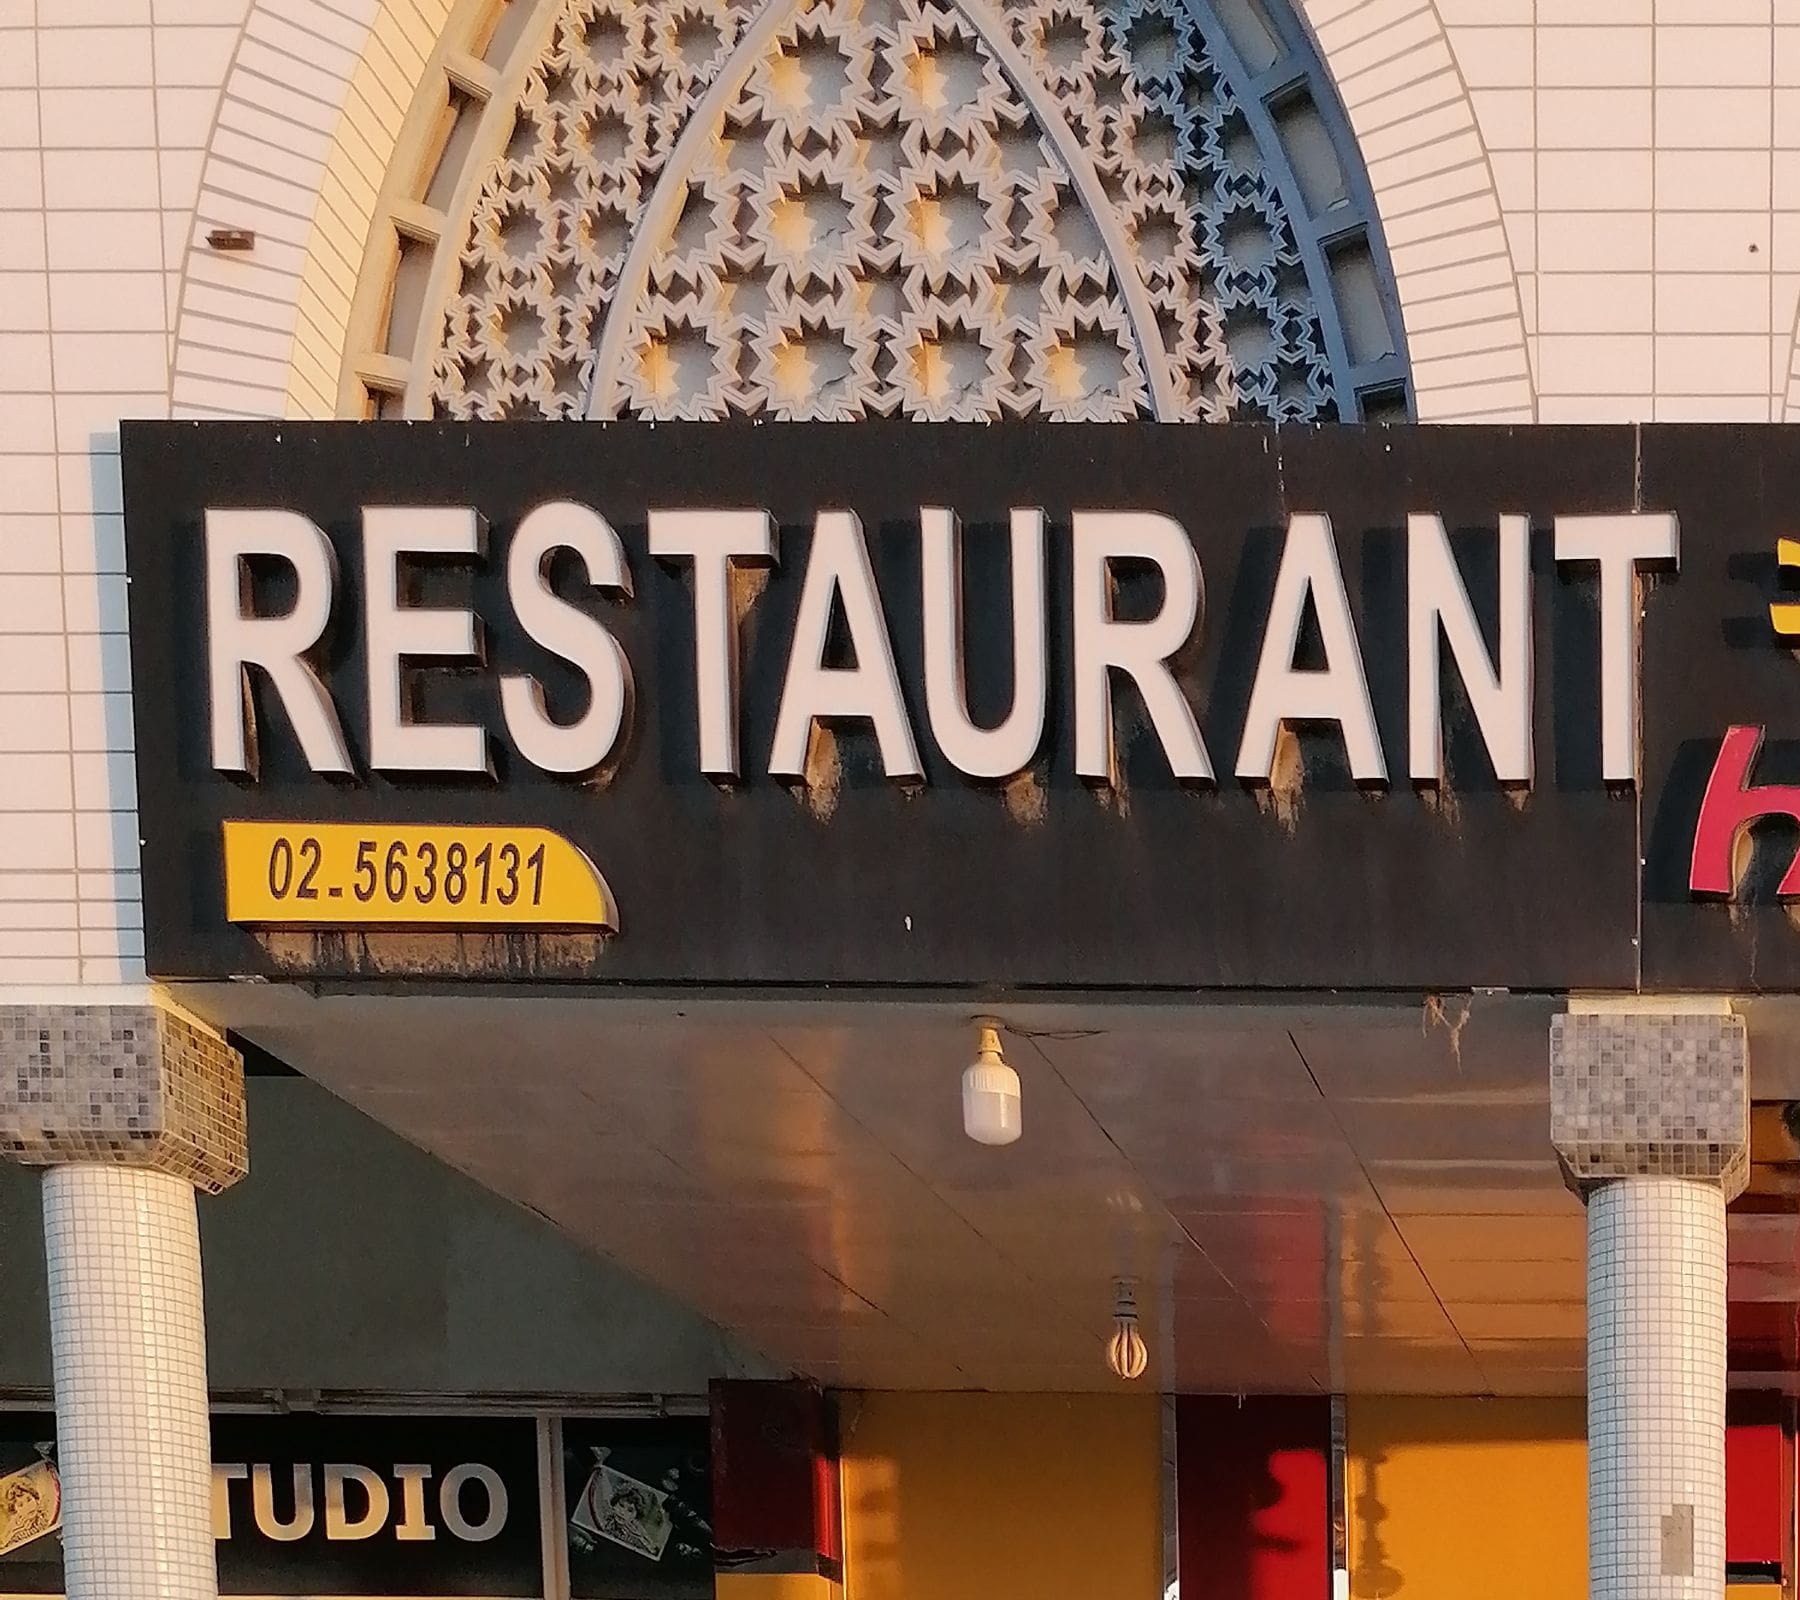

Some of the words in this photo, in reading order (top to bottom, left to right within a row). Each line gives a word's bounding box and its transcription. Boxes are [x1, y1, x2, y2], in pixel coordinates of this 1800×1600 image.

[204, 498, 1682, 785] RESTAURANT
[268, 836, 548, 906] 02.5638131
[211, 1463, 508, 1542] TUDIO
